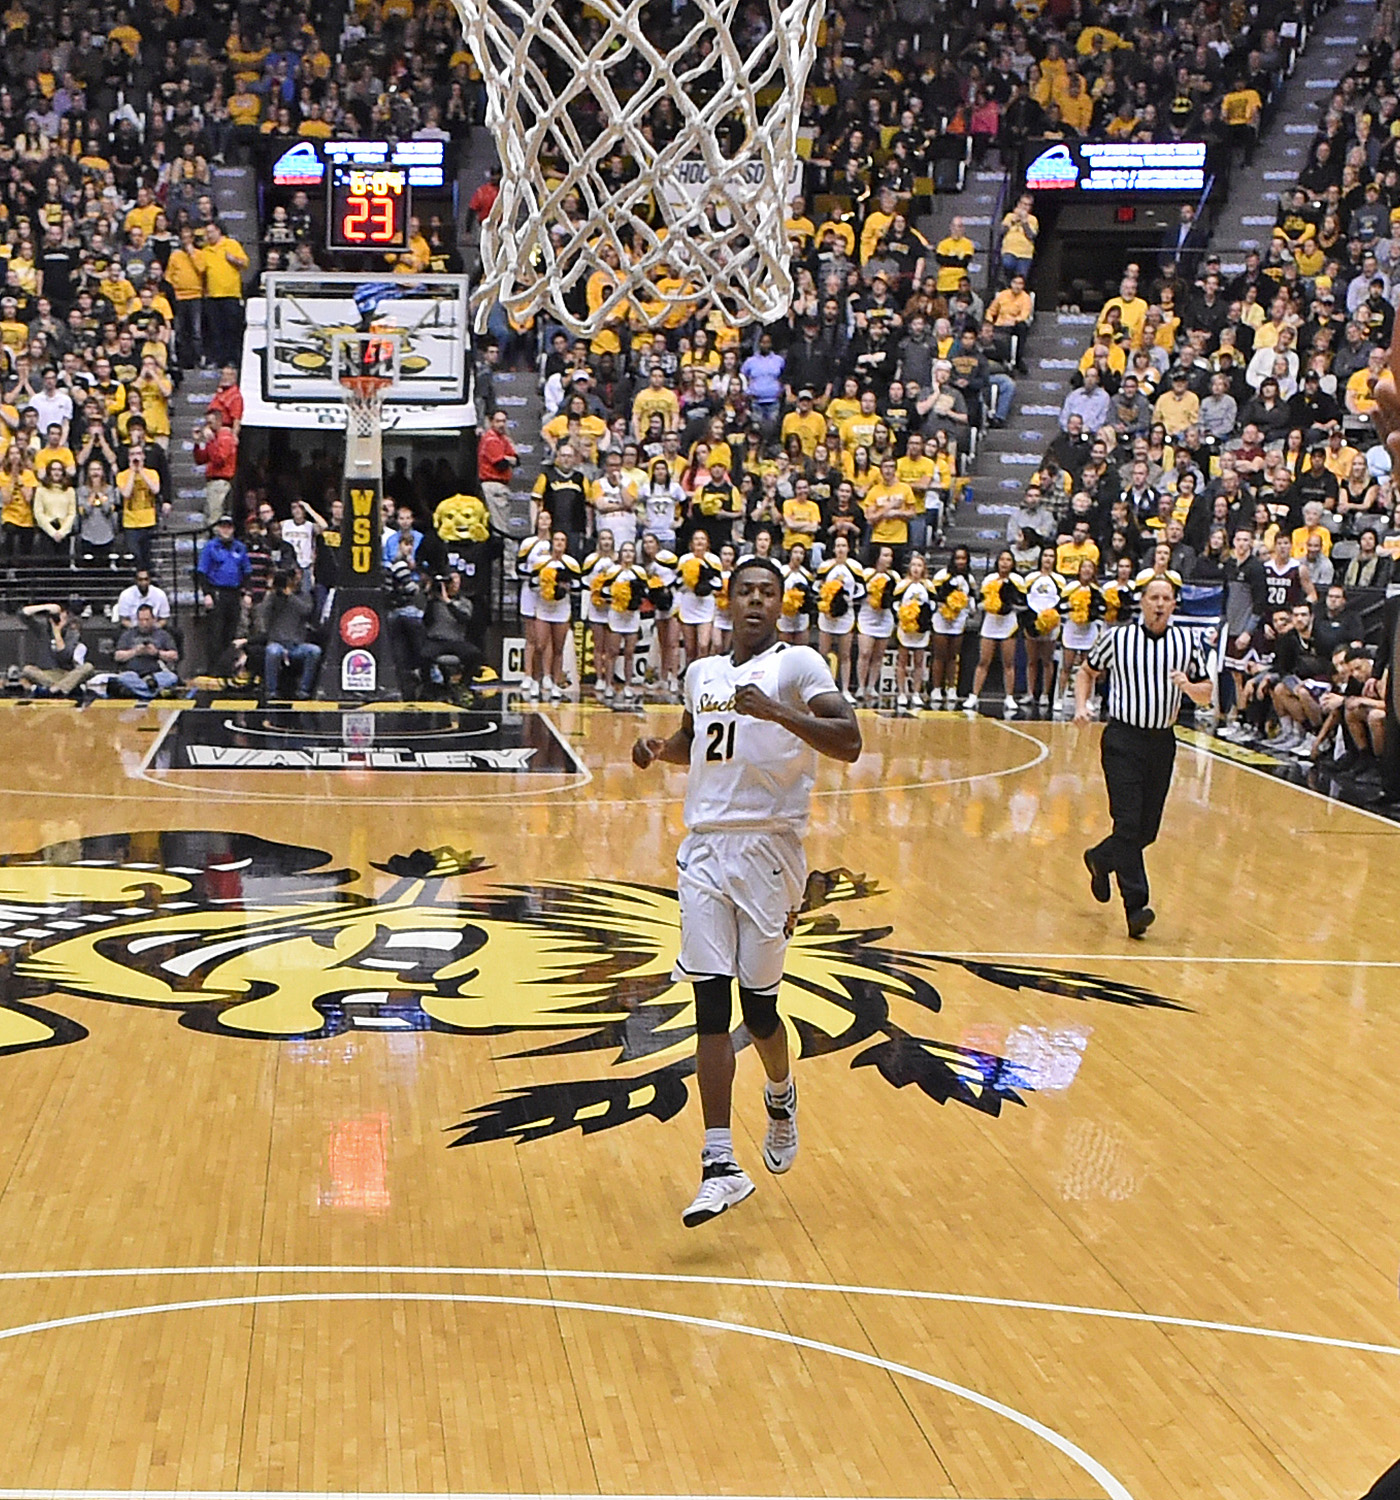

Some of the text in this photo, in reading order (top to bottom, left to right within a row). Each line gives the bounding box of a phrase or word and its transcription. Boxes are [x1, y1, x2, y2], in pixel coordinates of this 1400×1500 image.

[343, 196, 394, 242] 23
[350, 489, 375, 573] WSU
[1268, 587, 1287, 604] 20
[706, 720, 736, 763] 21
